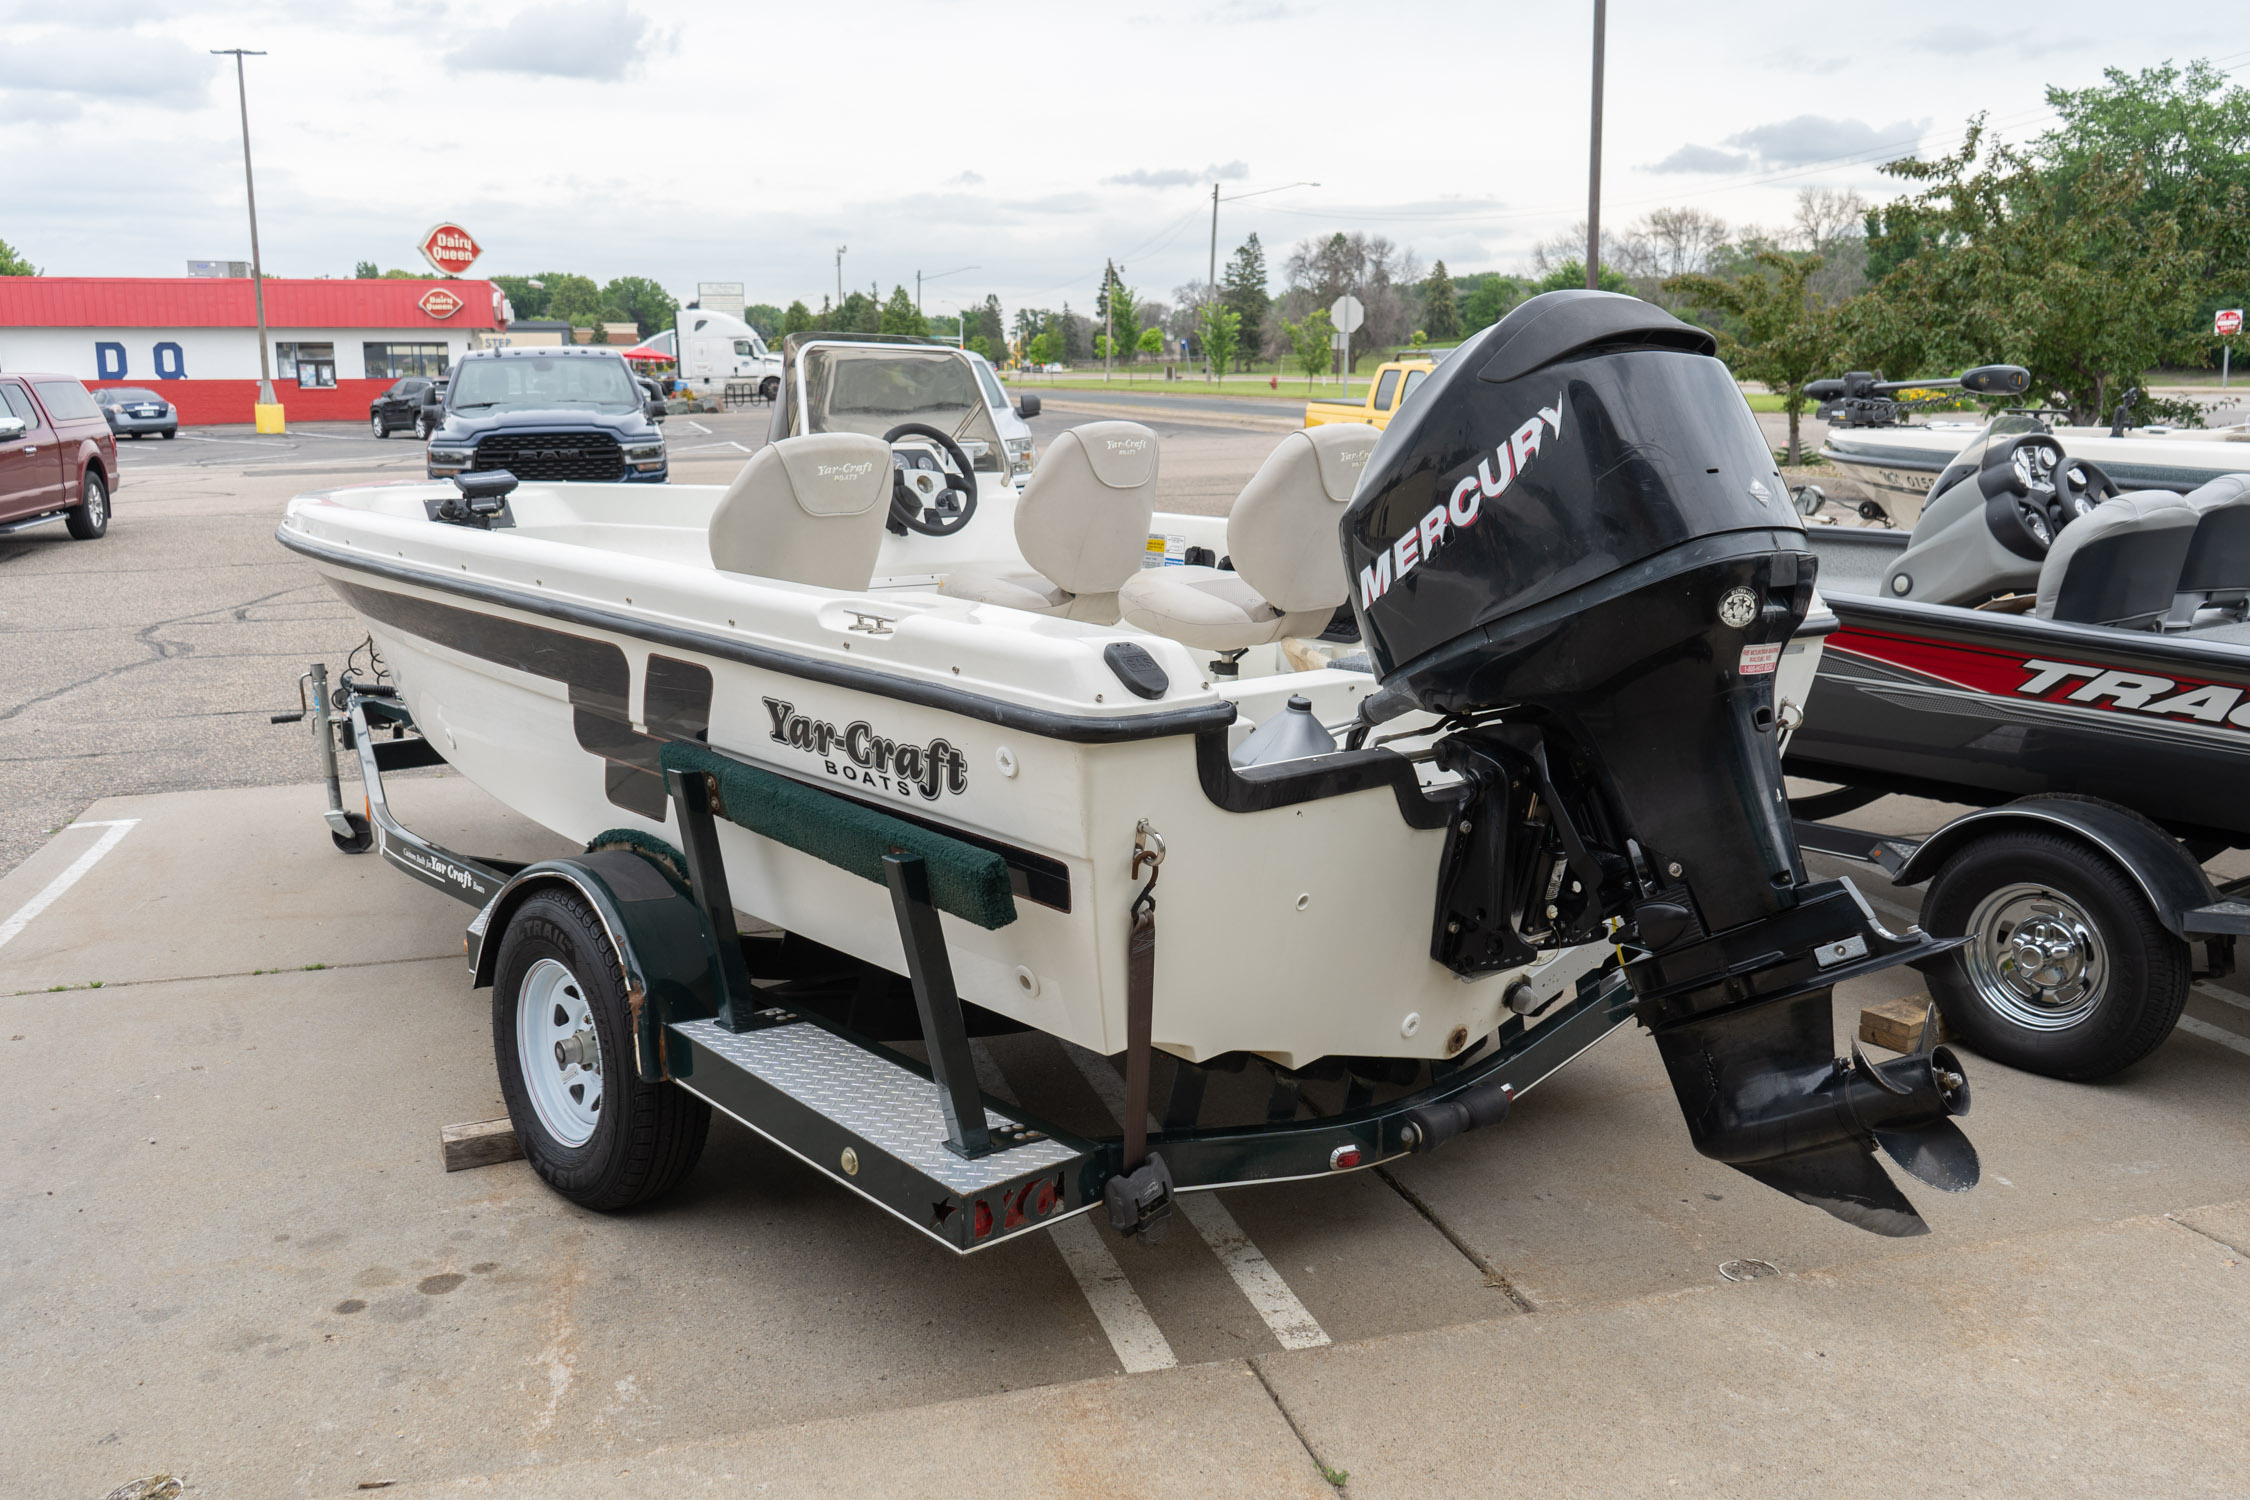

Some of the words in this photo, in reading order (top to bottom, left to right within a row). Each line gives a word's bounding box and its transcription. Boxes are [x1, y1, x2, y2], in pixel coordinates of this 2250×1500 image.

[437, 233, 472, 251] Dairy
[433, 246, 473, 261] Queen
[426, 303, 453, 311] Queen
[429, 295, 453, 305] Dairy
[817, 461, 873, 475] Yar-Craft
[1360, 390, 1563, 611] MERCURY
[762, 696, 968, 801] Yar-Craft
[824, 760, 911, 796] BOATS
[430, 856, 447, 874] Yar
[447, 865, 472, 888] Craft
